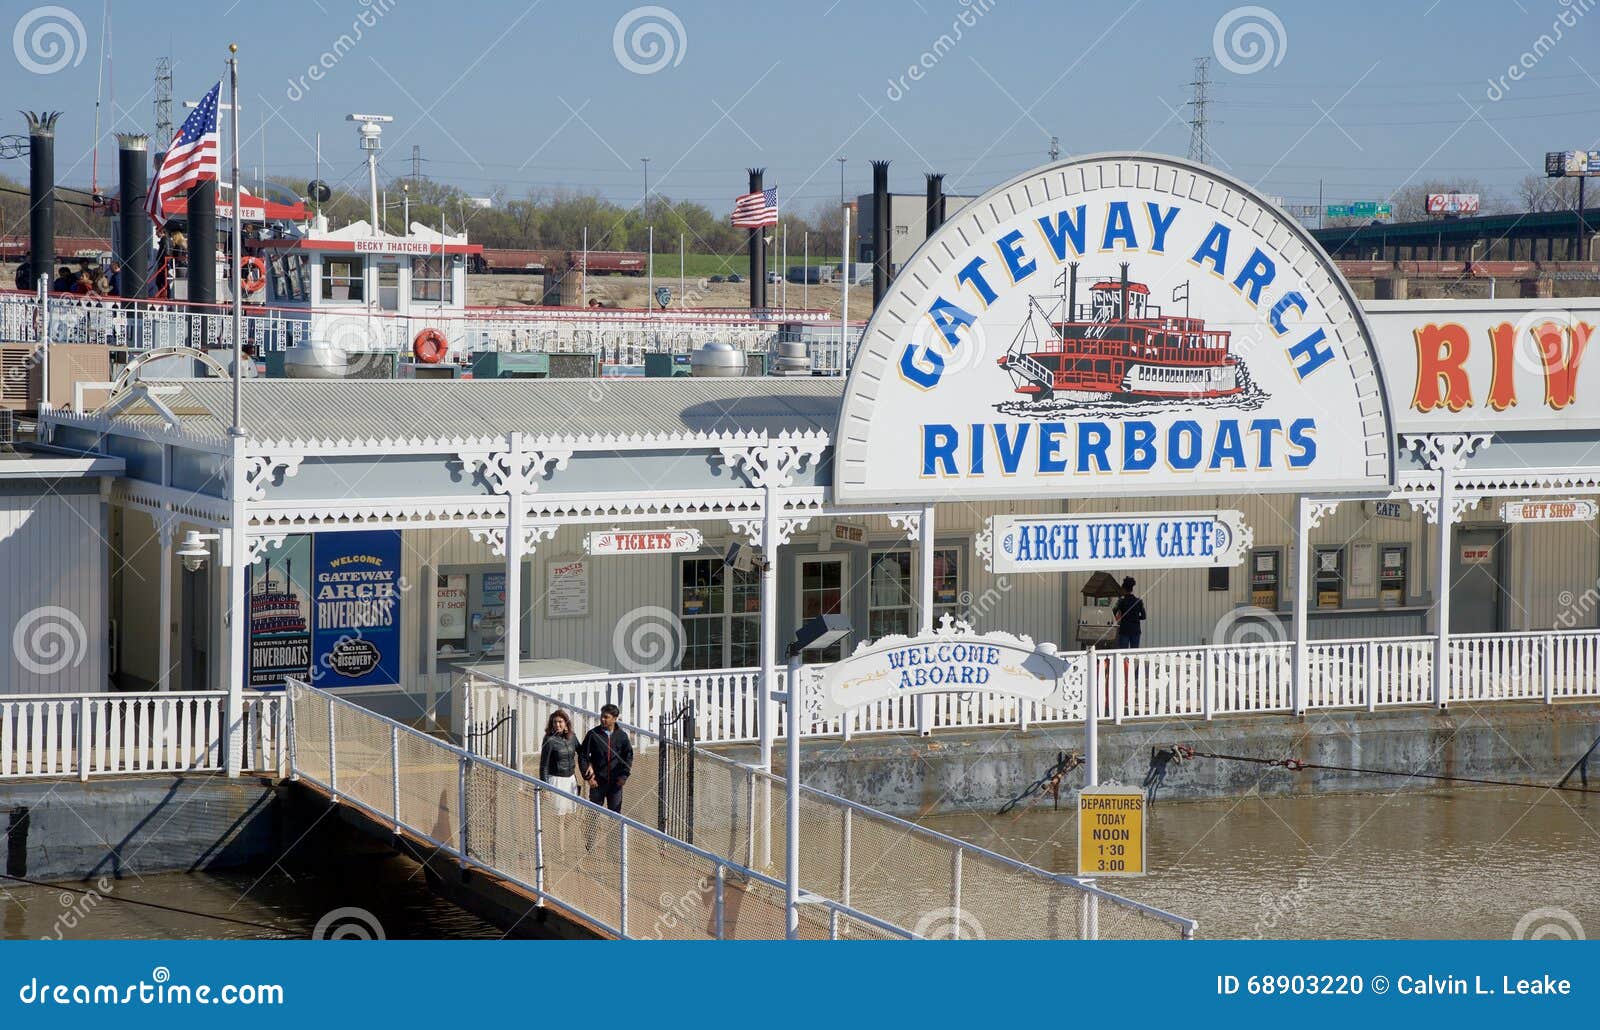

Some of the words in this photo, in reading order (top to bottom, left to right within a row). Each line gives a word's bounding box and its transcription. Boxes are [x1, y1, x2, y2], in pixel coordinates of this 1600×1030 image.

[357, 240, 384, 251] BECKY
[387, 242, 429, 253] THATCHER
[896, 201, 1181, 392] GATEWAY
[1188, 221, 1336, 384] ARCH
[1409, 321, 1596, 414] RIV
[920, 418, 1318, 478] RIVERBOATS
[1376, 501, 1401, 518] CAFE
[1521, 503, 1547, 519] GIFT
[1549, 502, 1577, 518] SHOP
[614, 533, 672, 551] TICKETS
[1015, 525, 1080, 562] ARCH
[1086, 522, 1150, 560] VIEW
[1156, 519, 1215, 558] CAFE
[330, 554, 383, 568] WELCOME
[318, 570, 394, 583] GATEWAY
[317, 583, 394, 600] ARCH
[318, 599, 393, 629] RIVERBOATS
[253, 645, 309, 668] RIVERBOATS
[337, 655, 372, 667] DISCOVERY
[887, 643, 1000, 670] WELCOME
[899, 665, 990, 689] ABOARD
[1081, 798, 1143, 810] DEPARTURES
[1096, 813, 1127, 825] TODAY
[1093, 829, 1130, 841] NOON
[1098, 859, 1125, 871] 3:00
